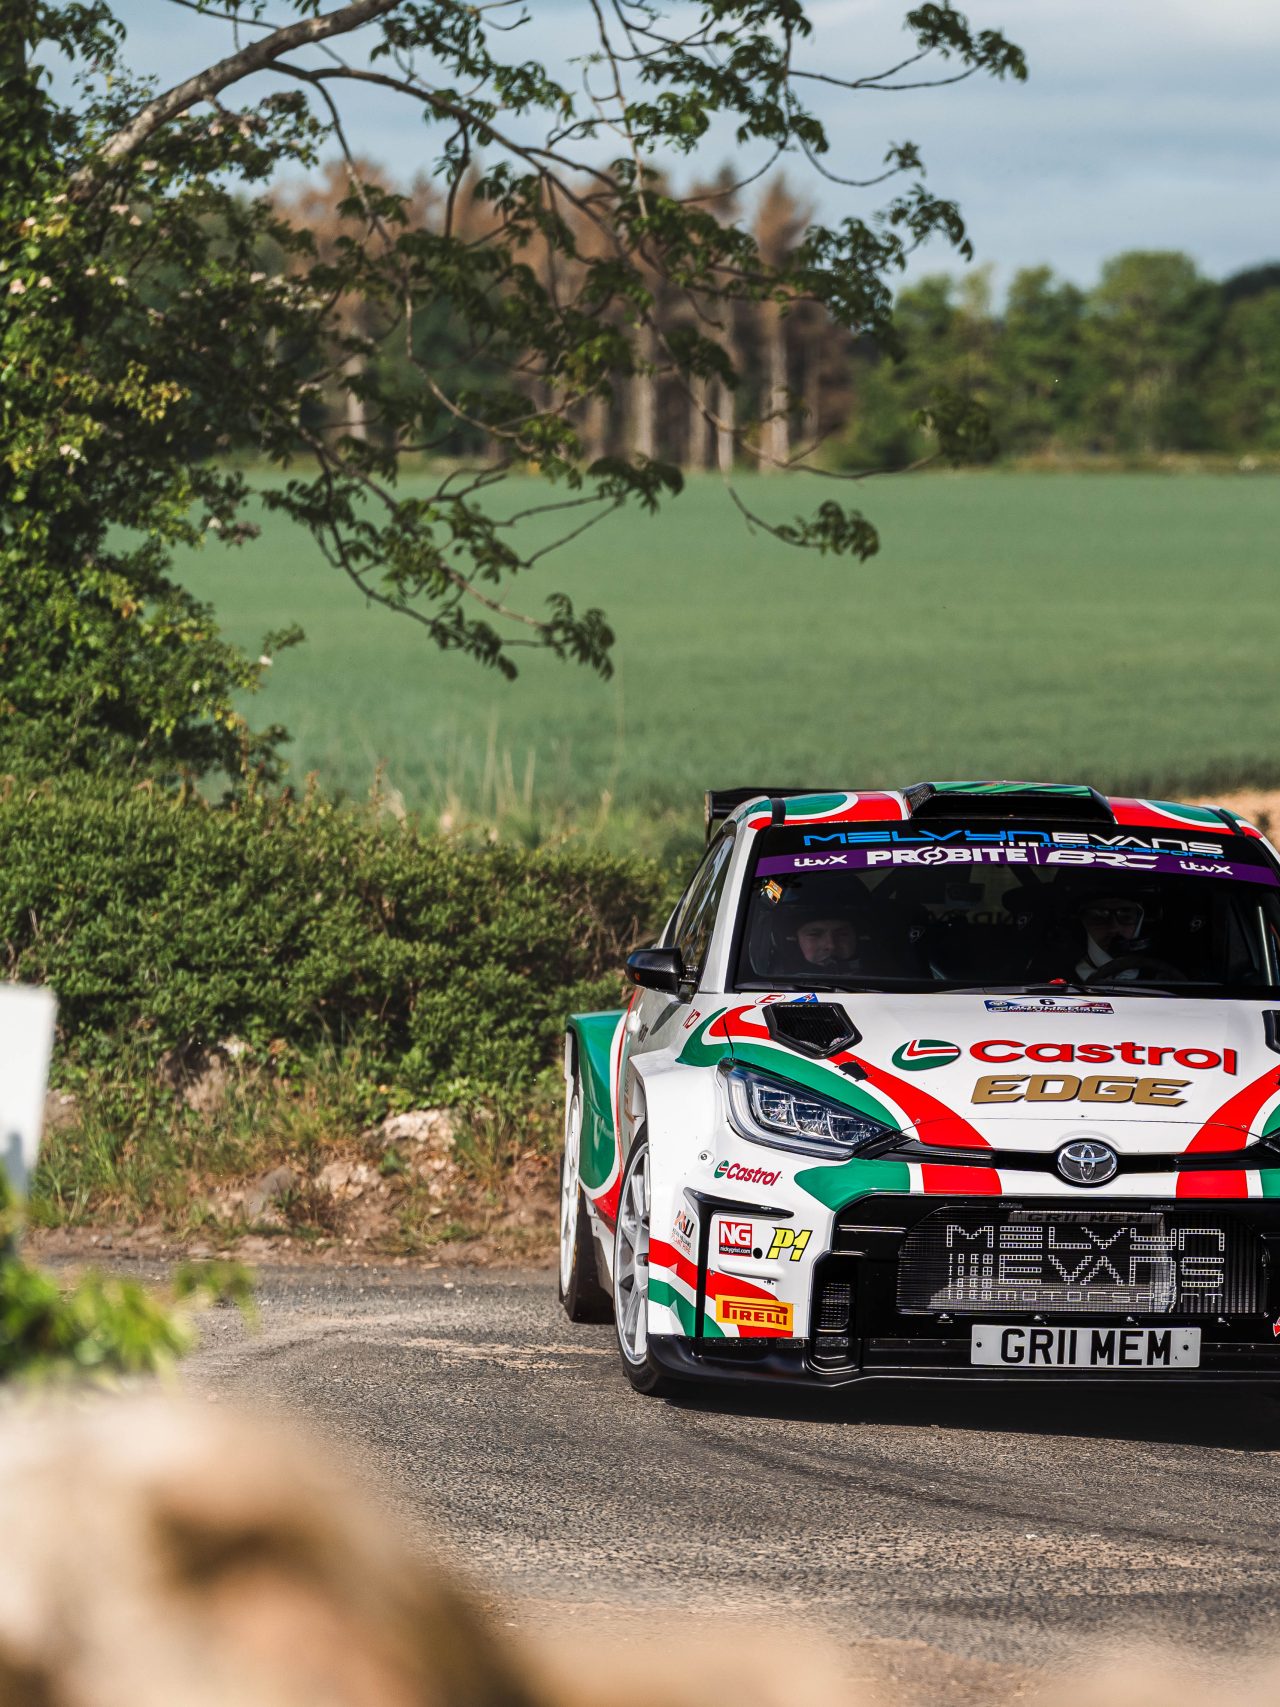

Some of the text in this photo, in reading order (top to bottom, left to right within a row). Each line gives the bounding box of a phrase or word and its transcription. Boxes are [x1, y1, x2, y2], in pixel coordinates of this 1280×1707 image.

[793, 855, 848, 868] itvX
[866, 846, 1159, 869] PROBITE BRC
[1179, 860, 1234, 875] itvX
[1039, 998, 1056, 1006] 6
[969, 1039, 1238, 1076] Castrol
[970, 1074, 1193, 1107] EDGE
[726, 1162, 782, 1187] Castrol
[720, 1222, 751, 1246] NG
[766, 1227, 813, 1262] P1
[998, 1254, 1225, 1289] EVANS
[722, 1300, 789, 1326] PIRELLI
[1001, 1328, 1172, 1366] GR11 MEM
